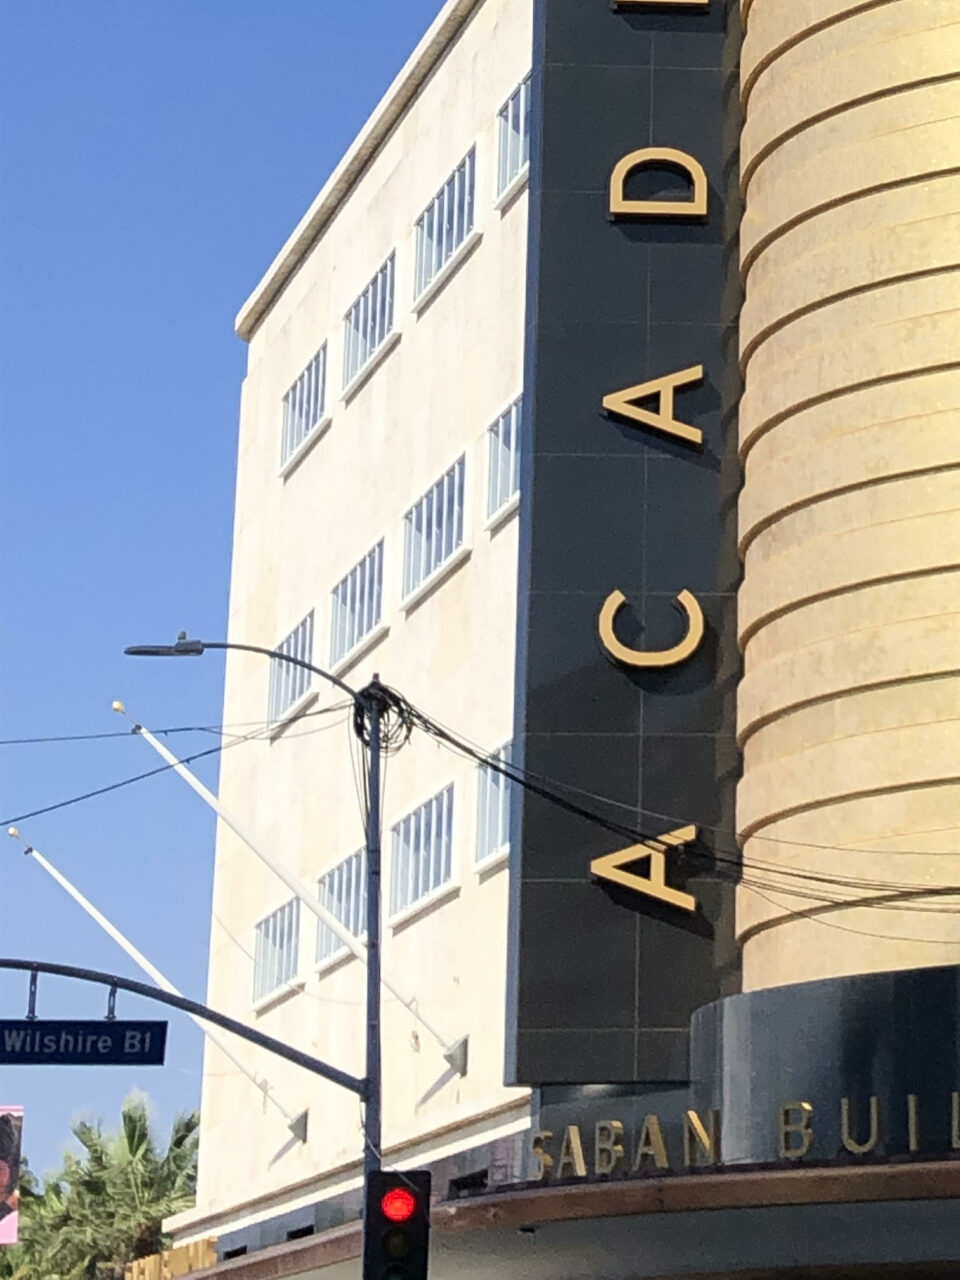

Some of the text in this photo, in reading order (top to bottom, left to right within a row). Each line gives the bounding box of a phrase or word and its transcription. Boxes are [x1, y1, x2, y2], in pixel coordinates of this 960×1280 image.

[4, 1029, 152, 1053] Wilshire Bl
[530, 1109, 724, 1178] SABAN
